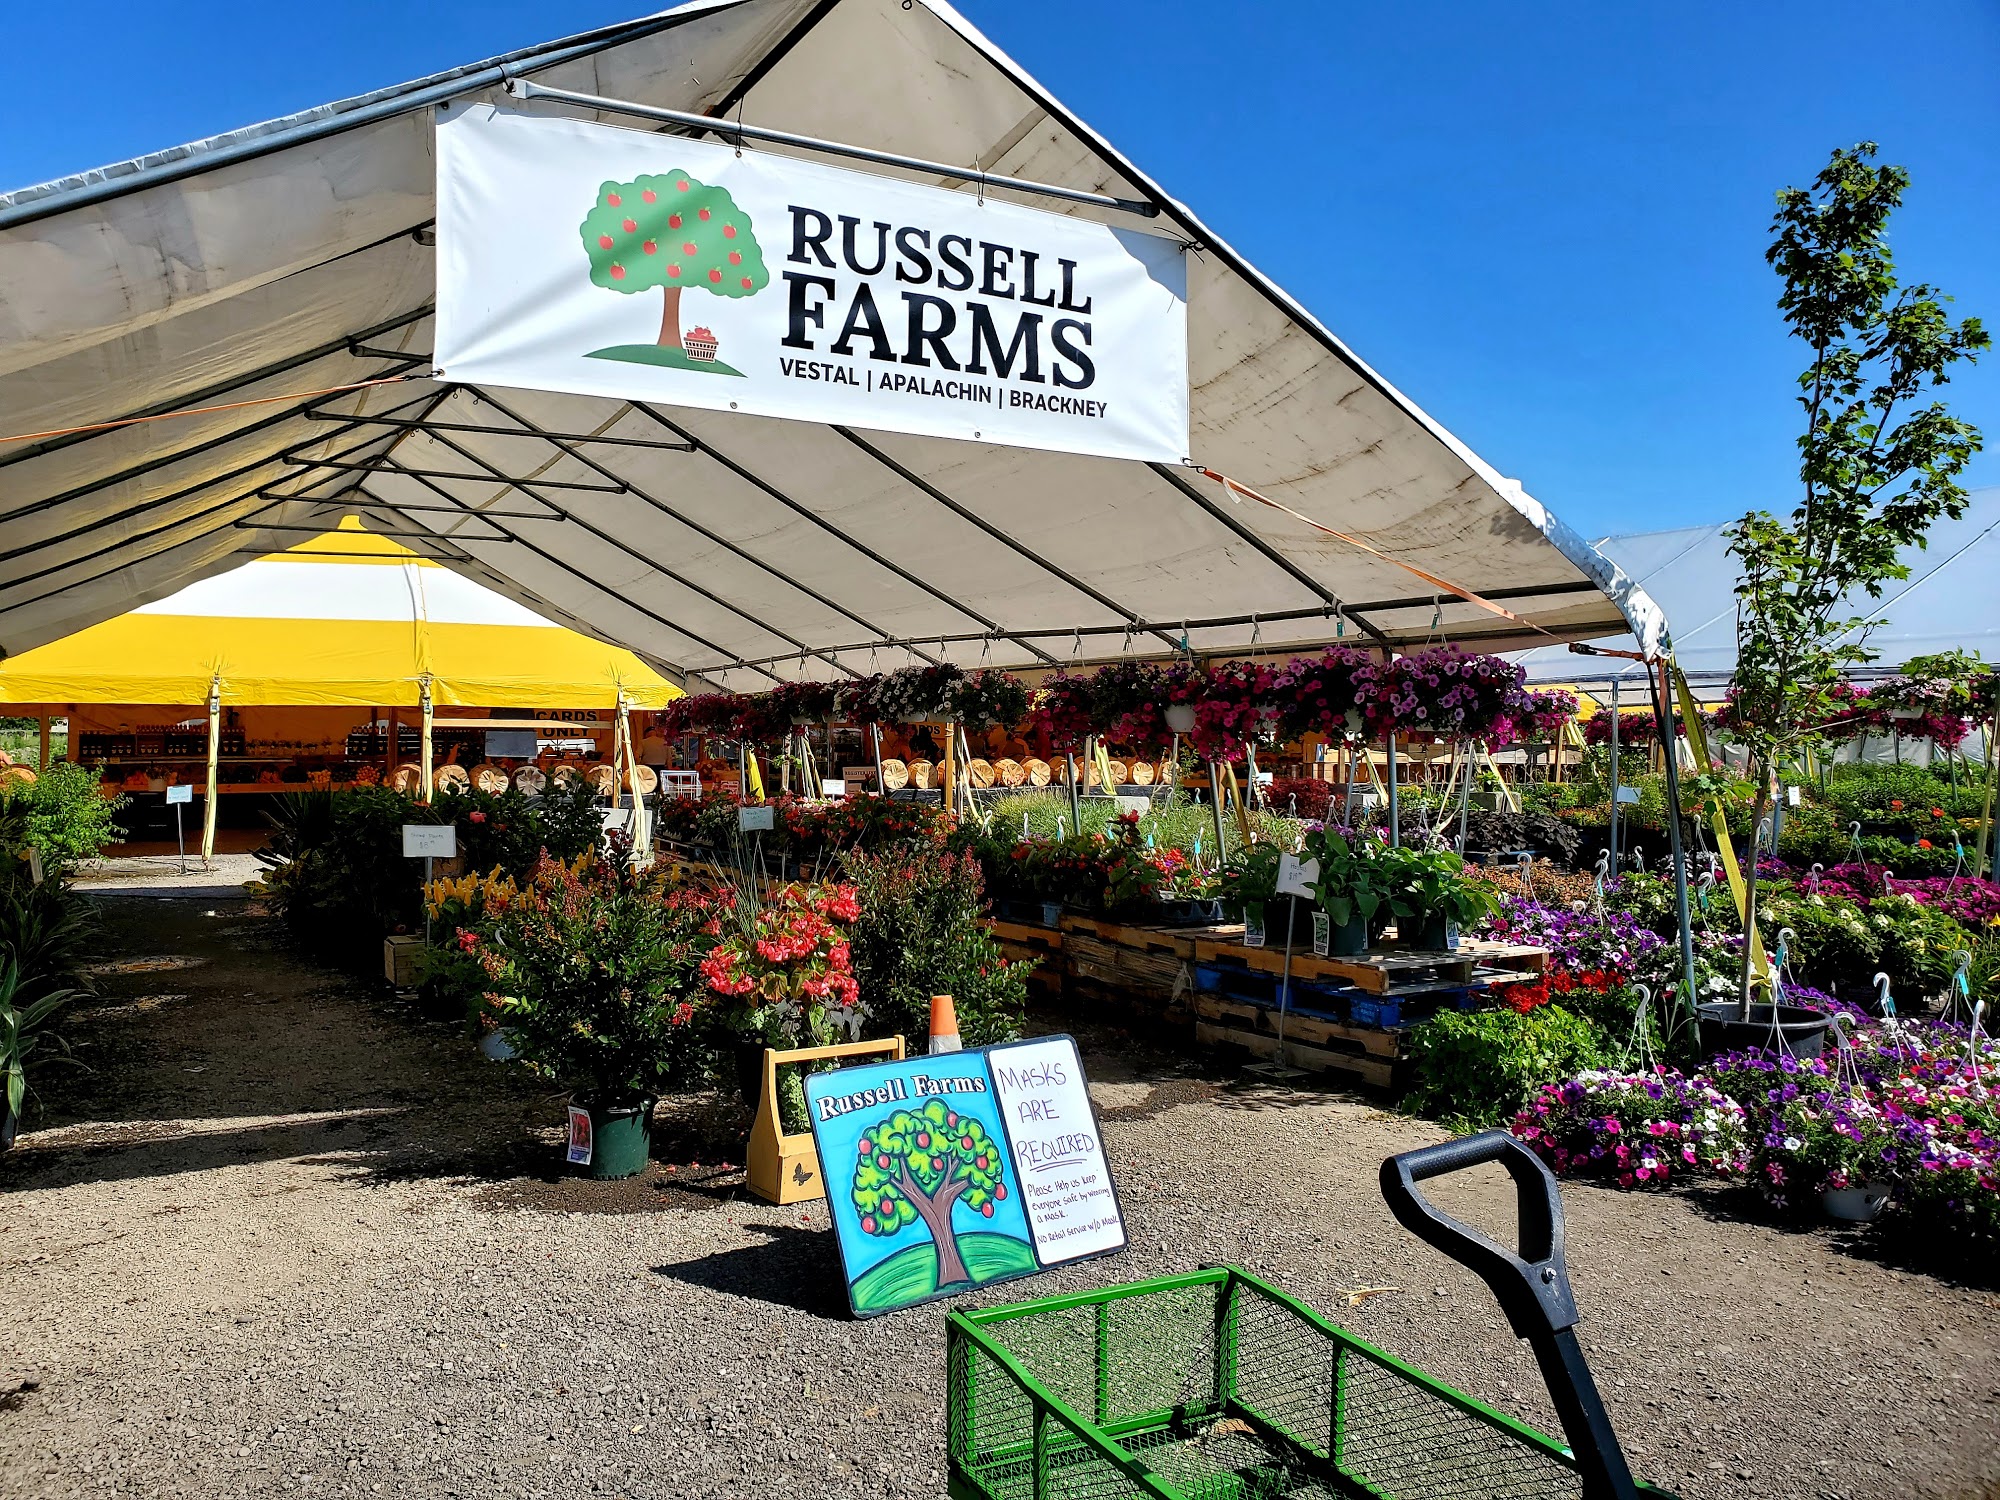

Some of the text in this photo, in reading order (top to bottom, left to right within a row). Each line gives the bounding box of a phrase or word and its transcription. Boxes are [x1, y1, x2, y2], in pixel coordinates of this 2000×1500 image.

[787, 204, 1092, 314] RUSSELL
[781, 271, 1096, 390] FARMS
[779, 357, 860, 386] VESTAL
[879, 372, 991, 403] APALACHIN
[1010, 390, 1107, 418] BRACKNEY
[535, 710, 597, 721] CARDS
[542, 727, 591, 737] ONLY
[998, 1061, 1067, 1094] MASKS
[817, 1074, 987, 1121] Russell Farms
[1018, 1099, 1060, 1123] ARE
[1016, 1133, 1094, 1167] REQUIRED
[1027, 1184, 1053, 1197] Please
[1032, 1199, 1062, 1211] everyone
[1079, 1192, 1088, 1202] by
[1037, 1215, 1044, 1223] a
